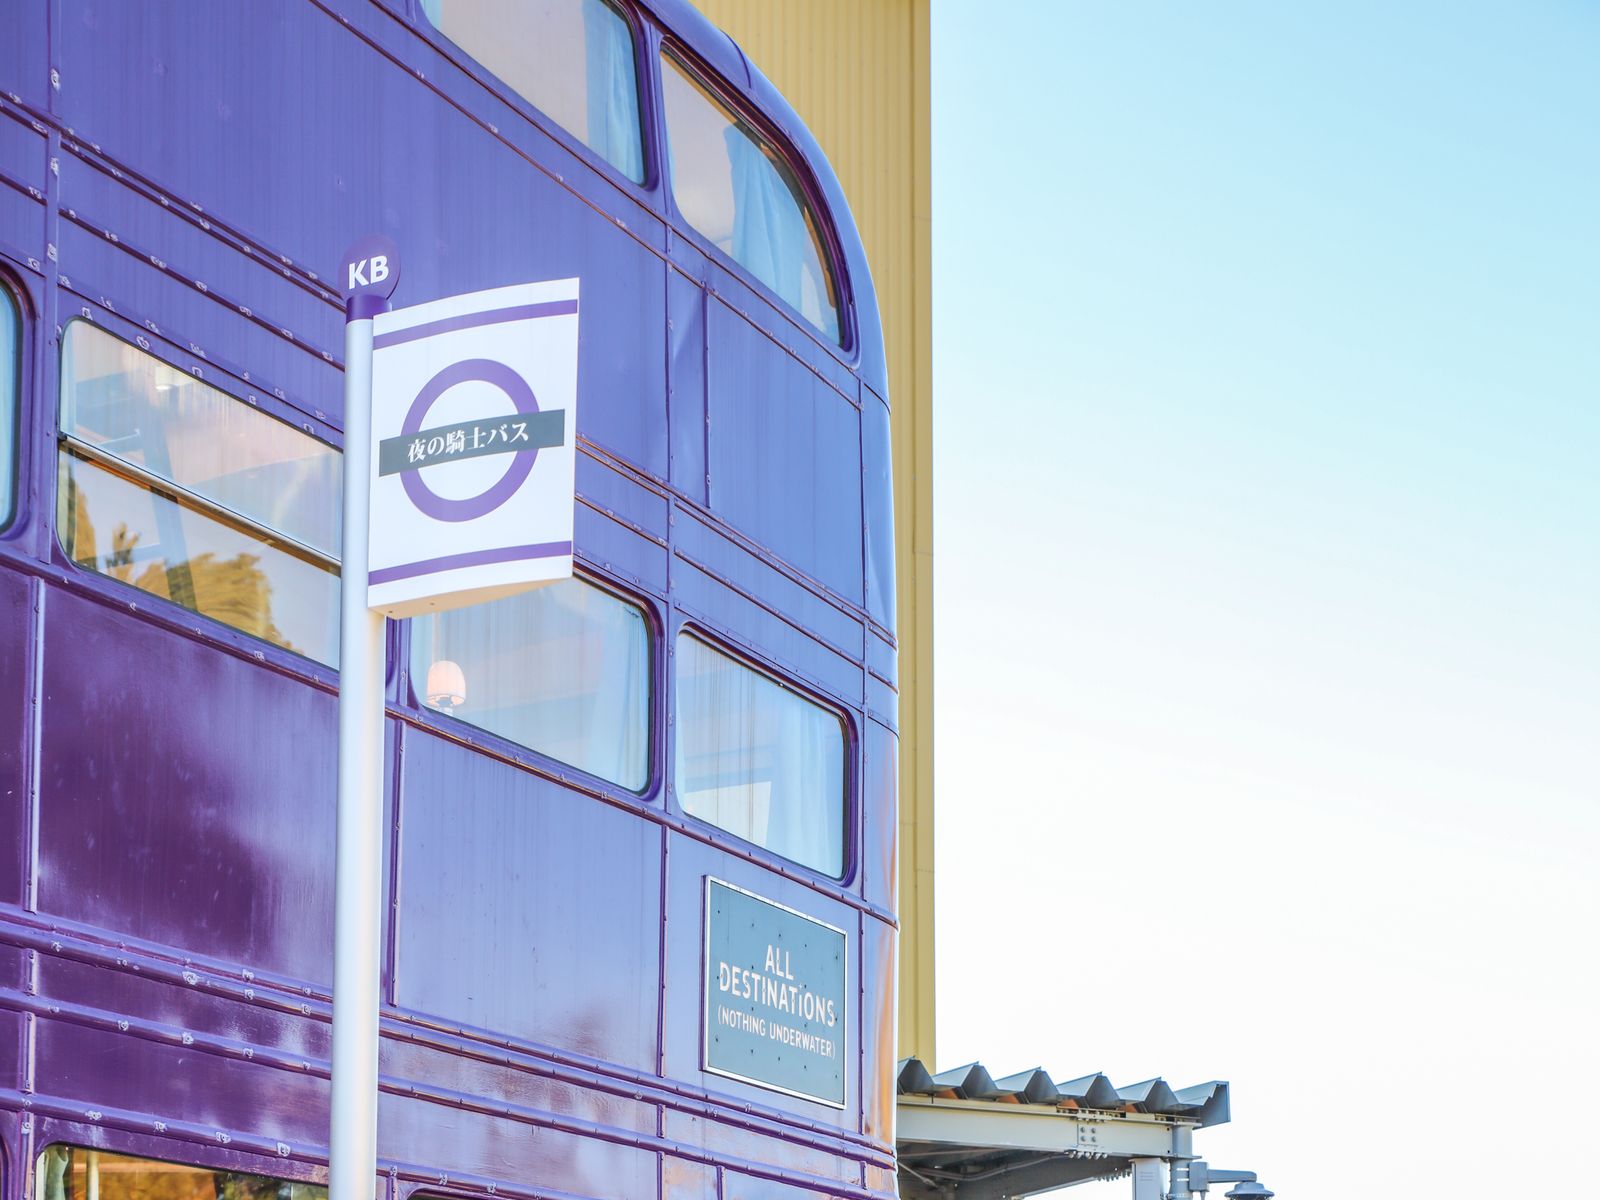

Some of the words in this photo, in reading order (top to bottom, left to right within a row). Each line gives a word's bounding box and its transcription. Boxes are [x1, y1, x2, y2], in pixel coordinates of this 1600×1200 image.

[348, 255, 390, 290] KB
[407, 422, 530, 464] 夜の騎士バス
[765, 944, 794, 981] ALL
[719, 961, 836, 1028] DESTINATIONS
[717, 1004, 767, 1037] (NOTHING
[769, 1023, 836, 1060] UNDERWATER)
